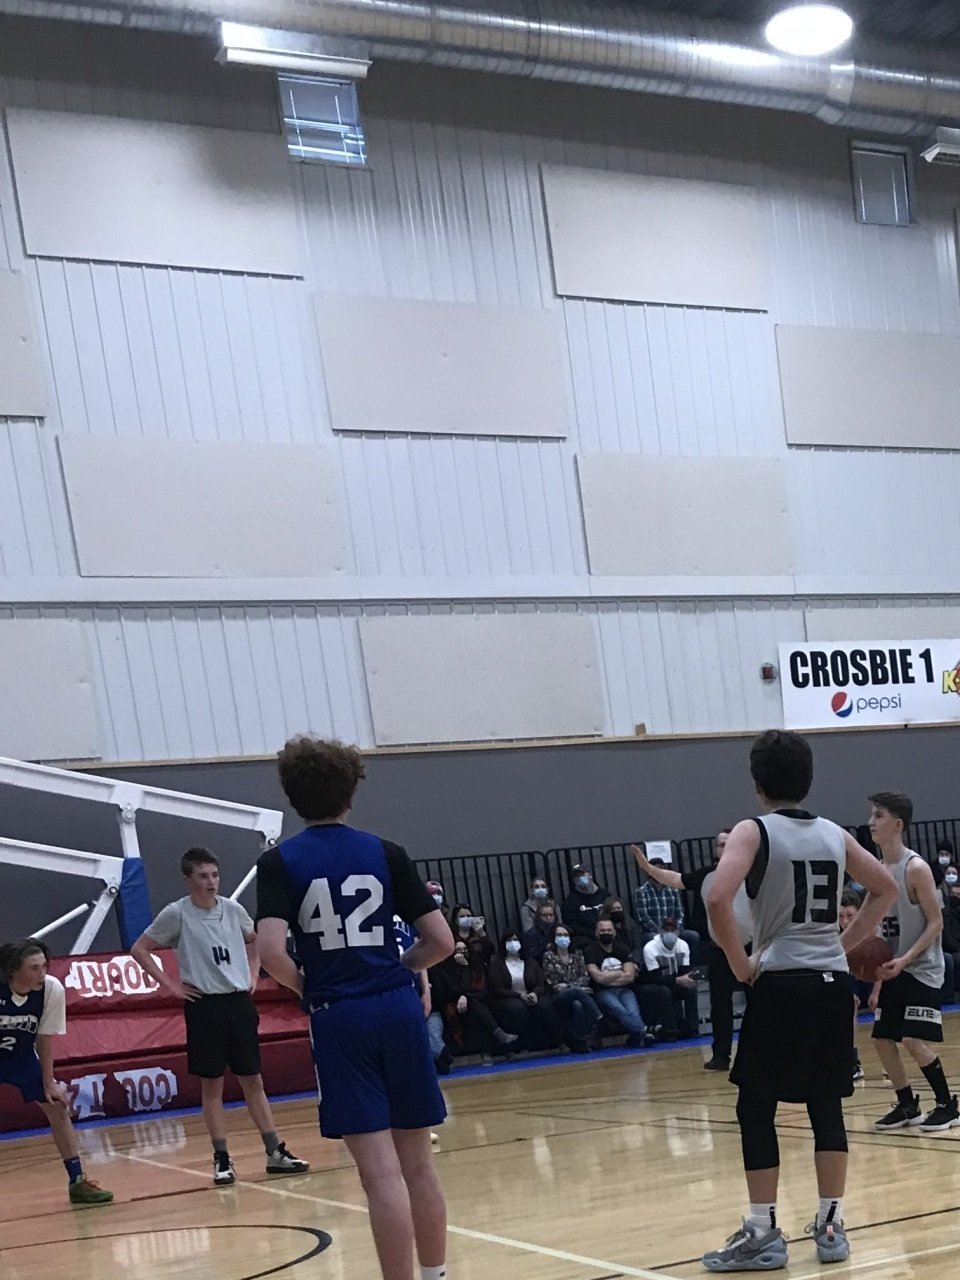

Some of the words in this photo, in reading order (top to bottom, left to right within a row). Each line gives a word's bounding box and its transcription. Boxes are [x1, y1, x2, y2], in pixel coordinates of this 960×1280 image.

[790, 649, 916, 688] CROSBIE
[919, 648, 934, 683] 1
[856, 693, 902, 713] pepsi
[791, 860, 838, 923] 13
[298, 874, 384, 950] 42
[211, 946, 232, 965] 14
